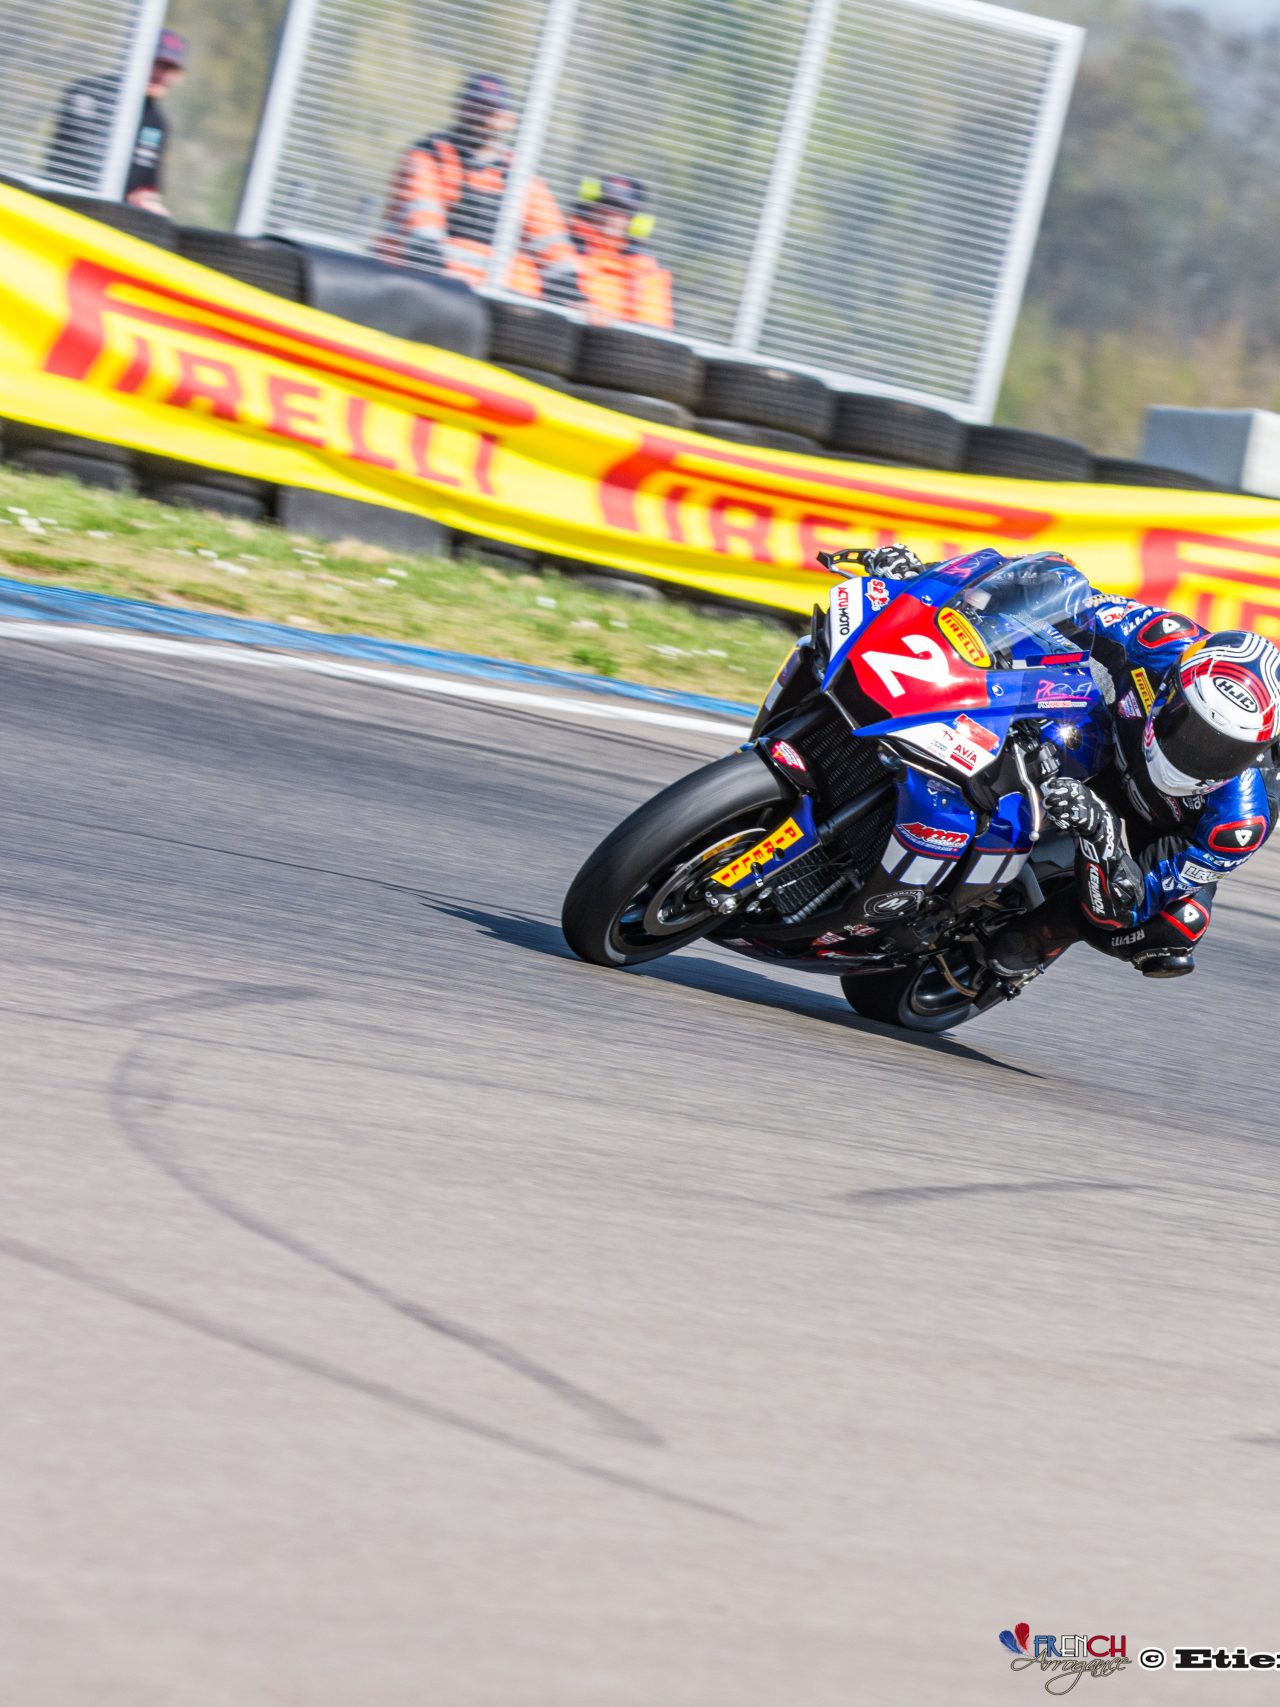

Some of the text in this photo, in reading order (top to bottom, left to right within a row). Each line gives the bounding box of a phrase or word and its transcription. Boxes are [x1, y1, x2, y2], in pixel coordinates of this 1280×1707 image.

[43, 258, 540, 497] PIRELLI
[940, 610, 985, 663] PIRELLI
[861, 634, 950, 698] 2
[1134, 671, 1153, 709] PIRELL
[1217, 680, 1256, 709] HJC
[721, 826, 797, 881] PIRELLI
